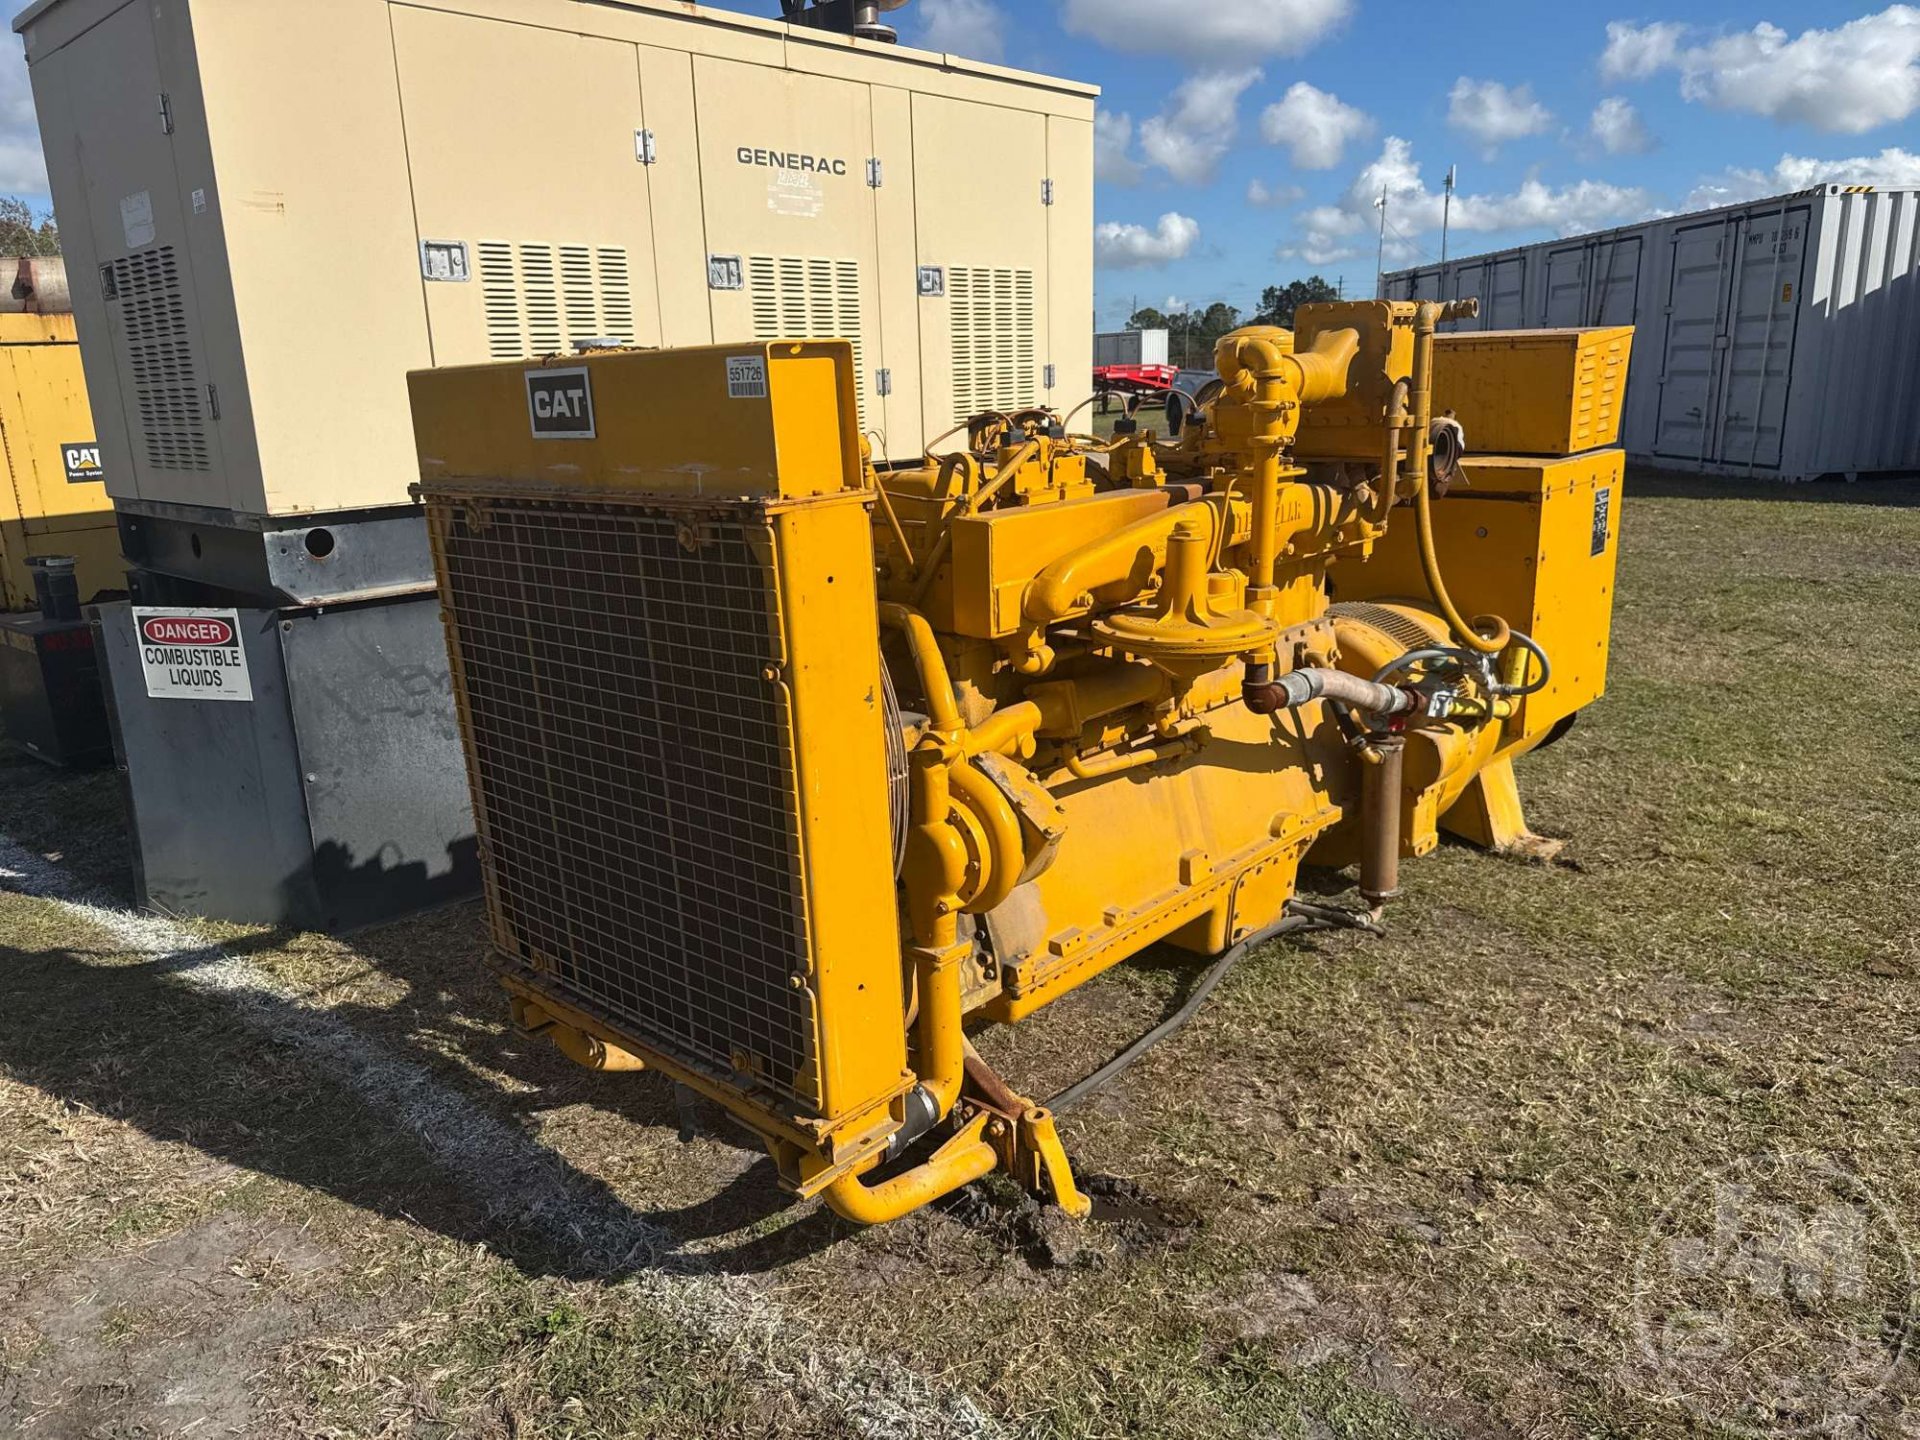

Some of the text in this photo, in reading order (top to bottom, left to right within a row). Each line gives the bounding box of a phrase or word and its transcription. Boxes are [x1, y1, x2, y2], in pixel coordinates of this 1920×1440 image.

[737, 147, 846, 176] GENERAC
[730, 366, 763, 381] 551726
[533, 388, 584, 418] CAT
[66, 448, 102, 470] CAT
[153, 623, 222, 640] DANGER
[145, 647, 241, 667] COMBUSTIBLE
[169, 668, 223, 687] LIQUIDS
